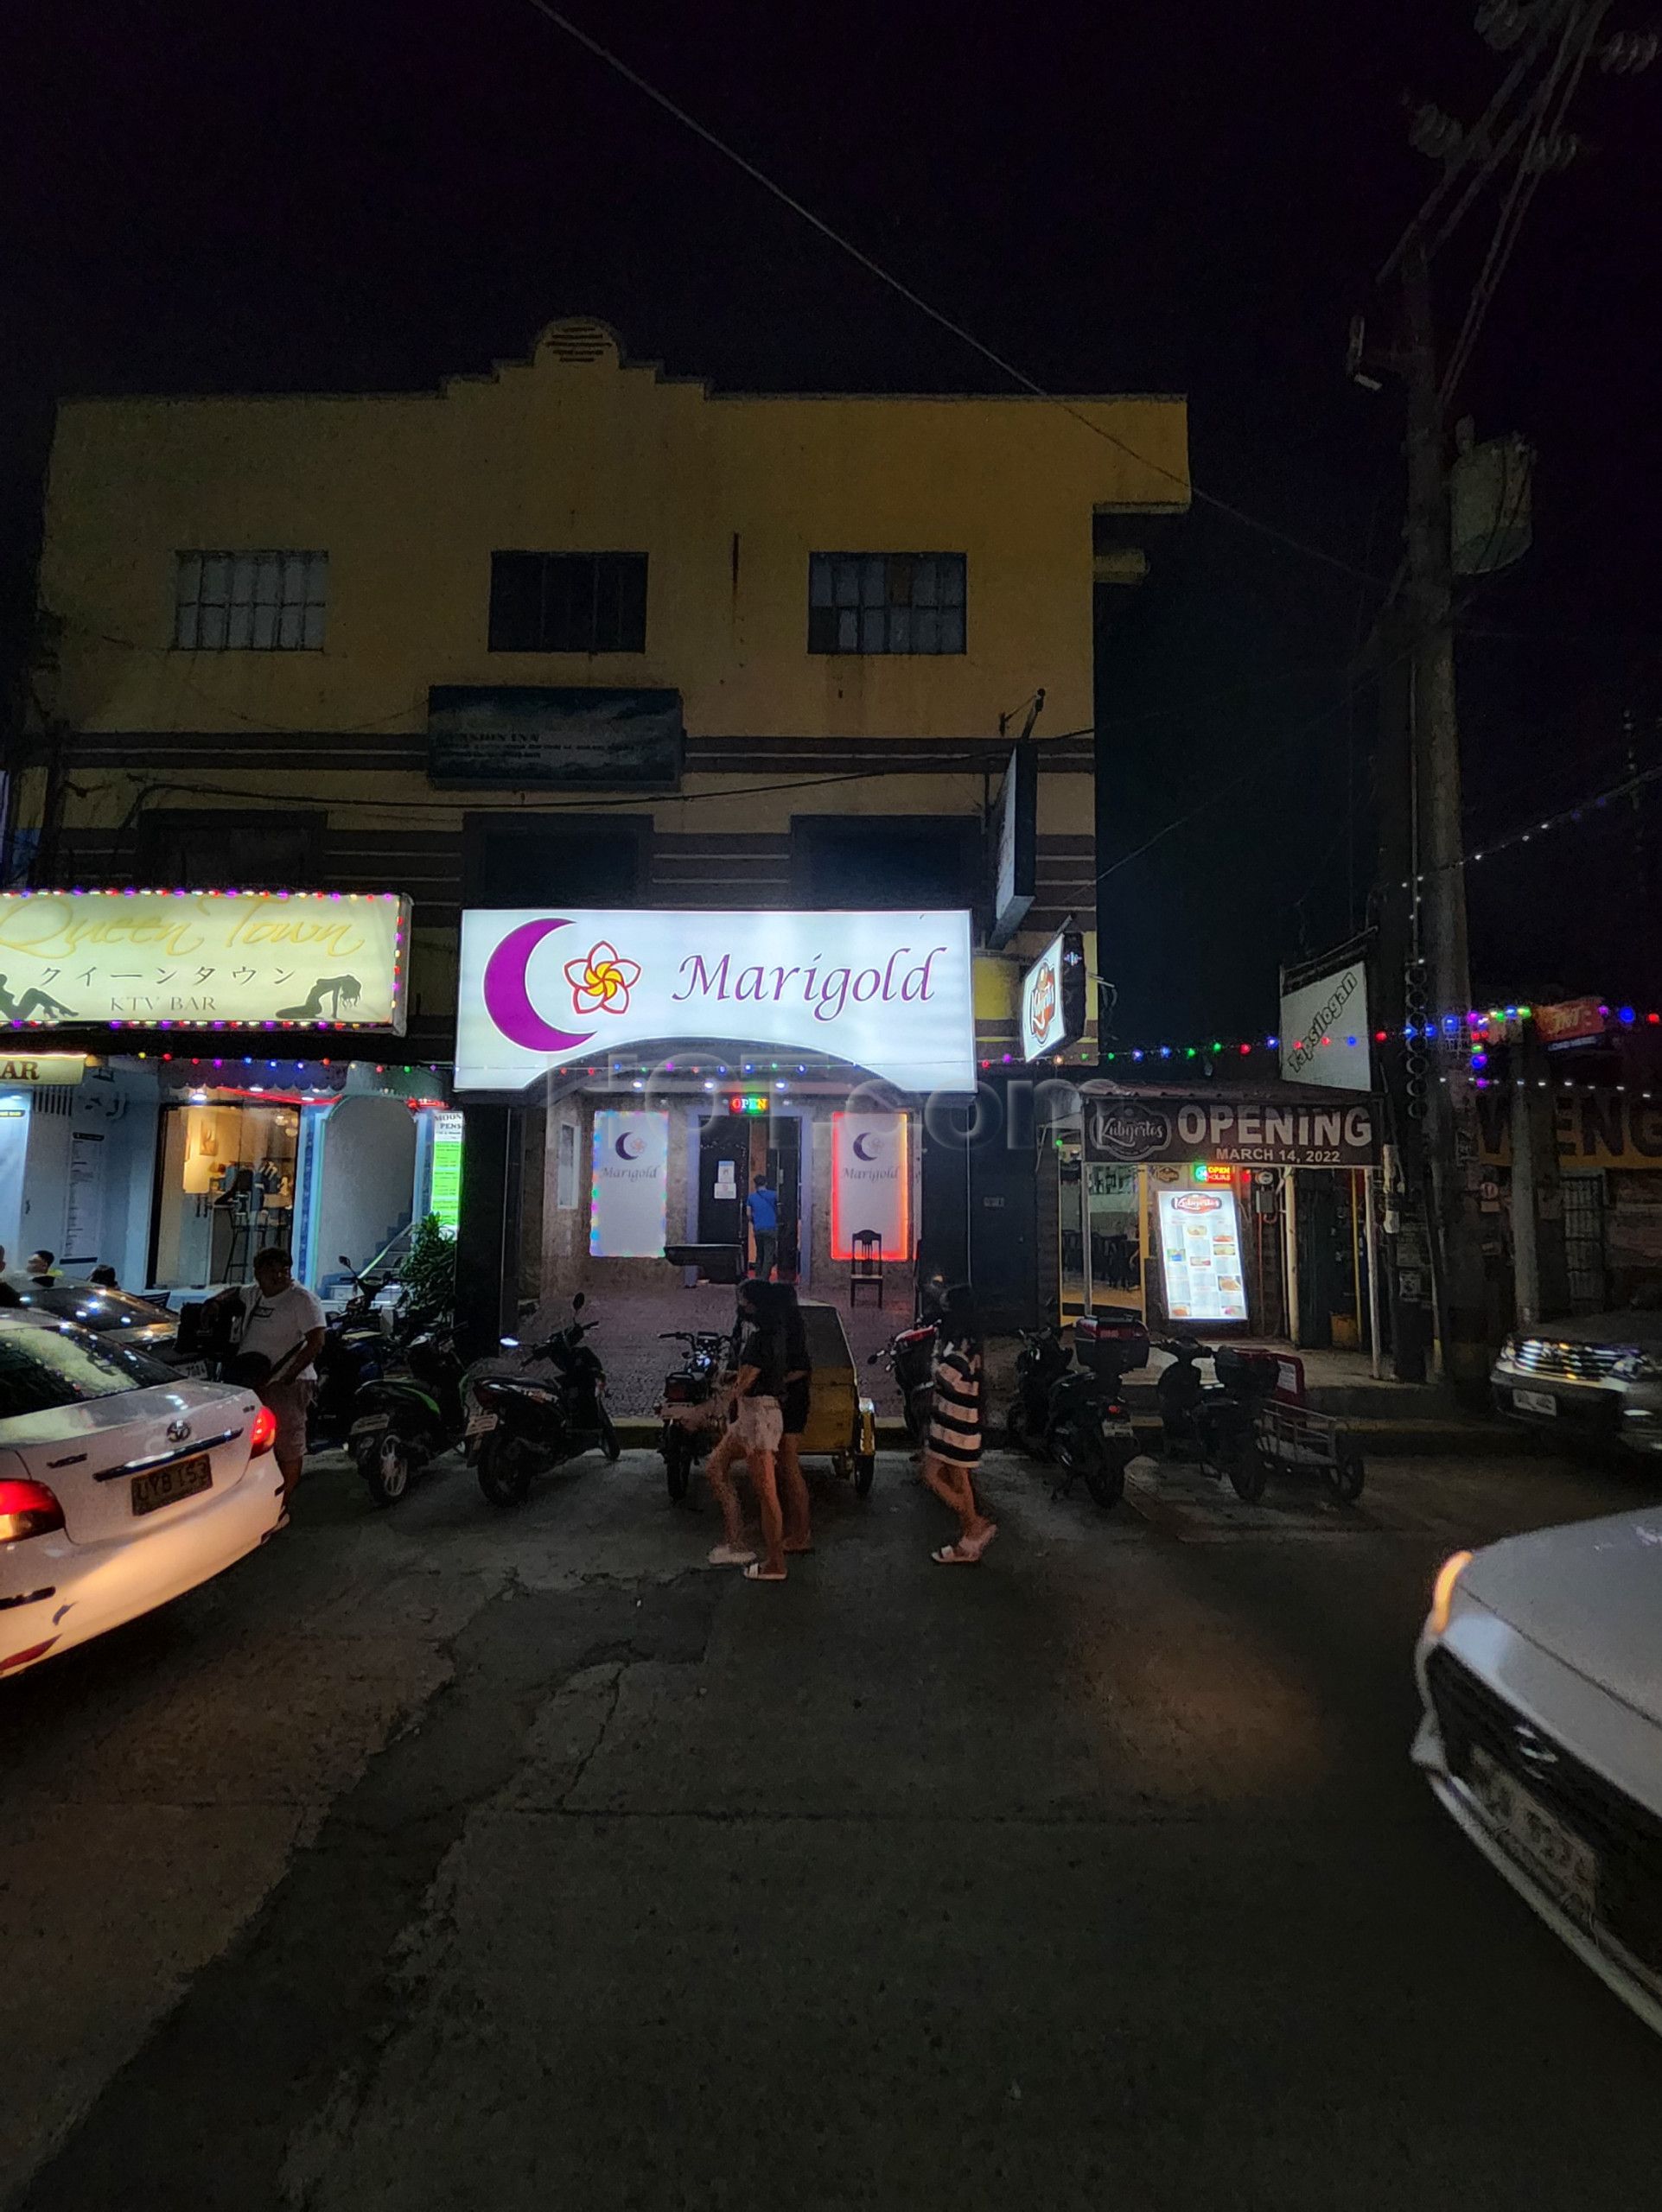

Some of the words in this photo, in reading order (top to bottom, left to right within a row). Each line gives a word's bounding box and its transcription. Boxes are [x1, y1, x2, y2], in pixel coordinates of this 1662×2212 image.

[0, 897, 205, 959] Queen
[197, 896, 365, 957] Town
[40, 965, 296, 988] クイーンタウン
[671, 946, 947, 1021] Marigold
[110, 995, 162, 1012] KTV
[169, 995, 217, 1011] BAR
[730, 1098, 769, 1110] OPEN
[1176, 1105, 1372, 1147] OPENING
[1215, 1148, 1274, 1160] MARCH
[1278, 1150, 1301, 1163] 14,
[1306, 1150, 1341, 1162] 2022
[602, 1165, 661, 1182] Marigold
[842, 1165, 901, 1183] Marigold
